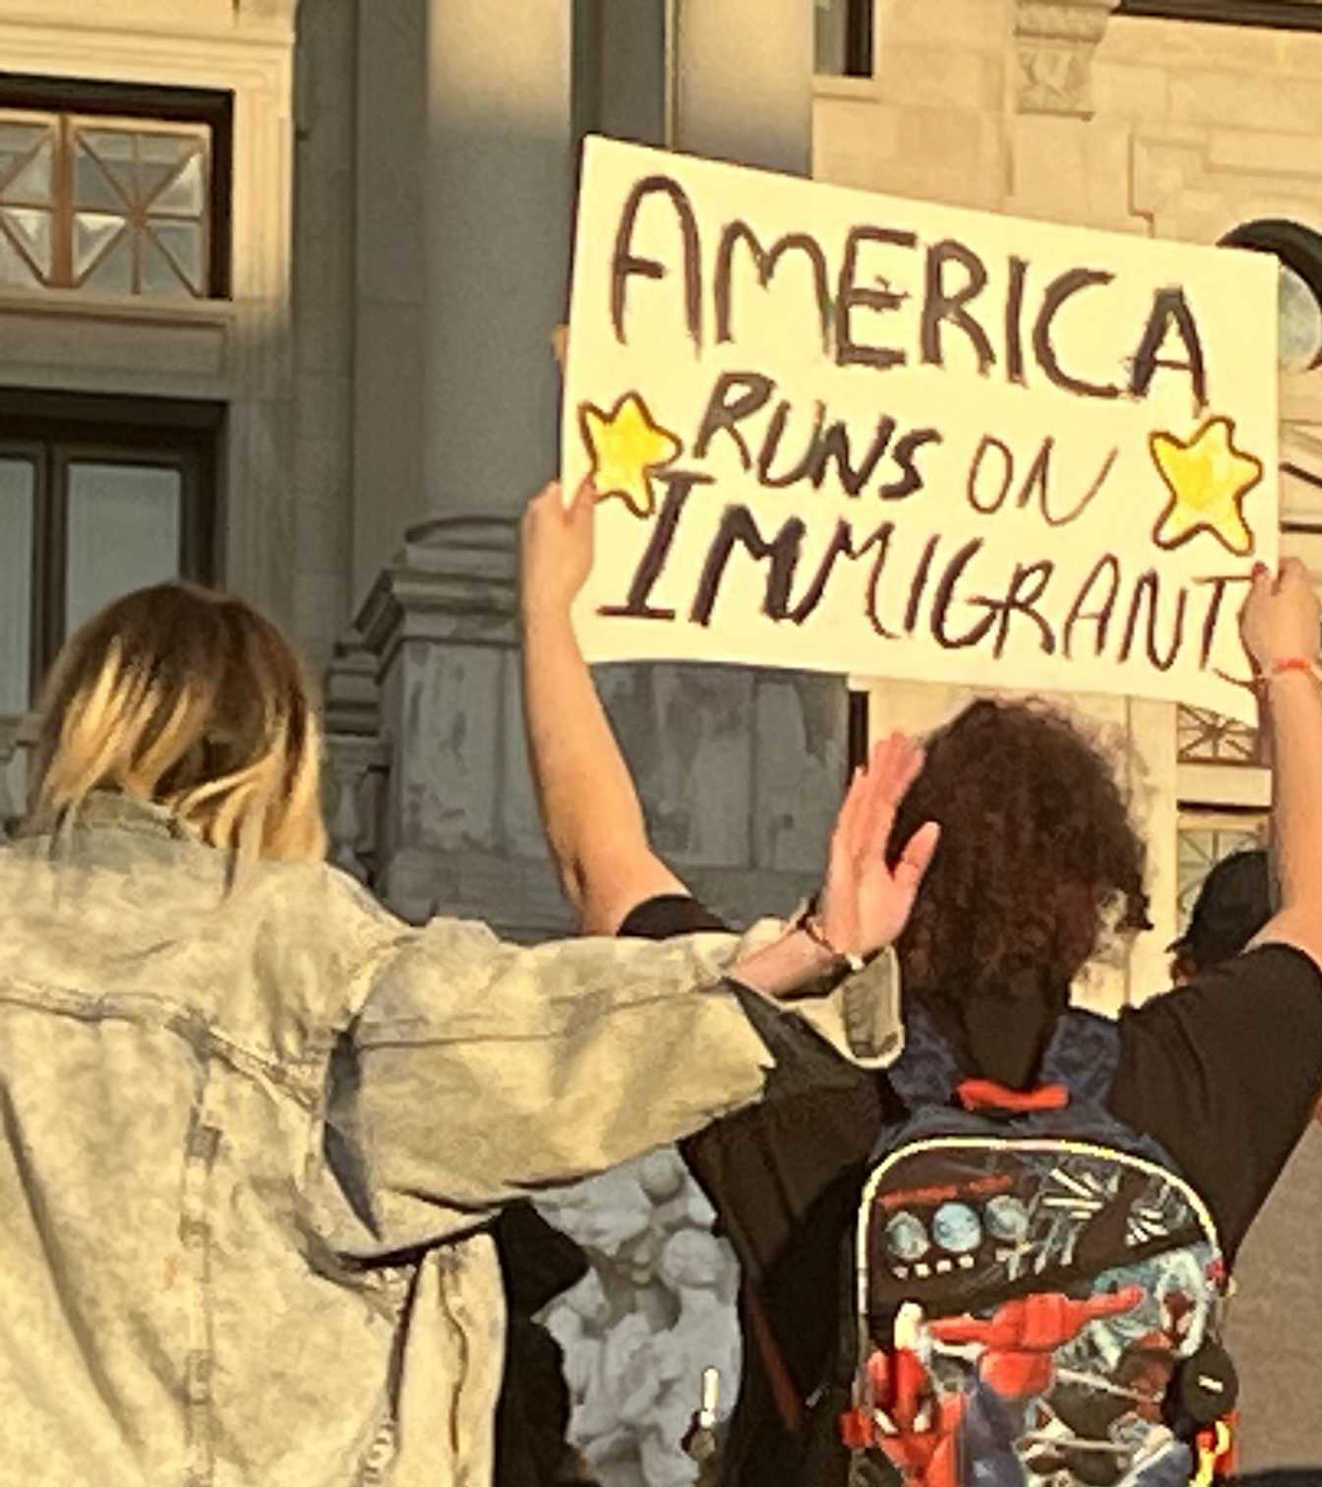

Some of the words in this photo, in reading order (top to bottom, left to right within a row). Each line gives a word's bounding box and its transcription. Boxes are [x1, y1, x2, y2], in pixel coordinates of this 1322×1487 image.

[609, 174, 1209, 410] AMERICA
[692, 371, 943, 501] RUNS
[966, 434, 1119, 527] ON
[594, 470, 1260, 686] IMMIGRANT
